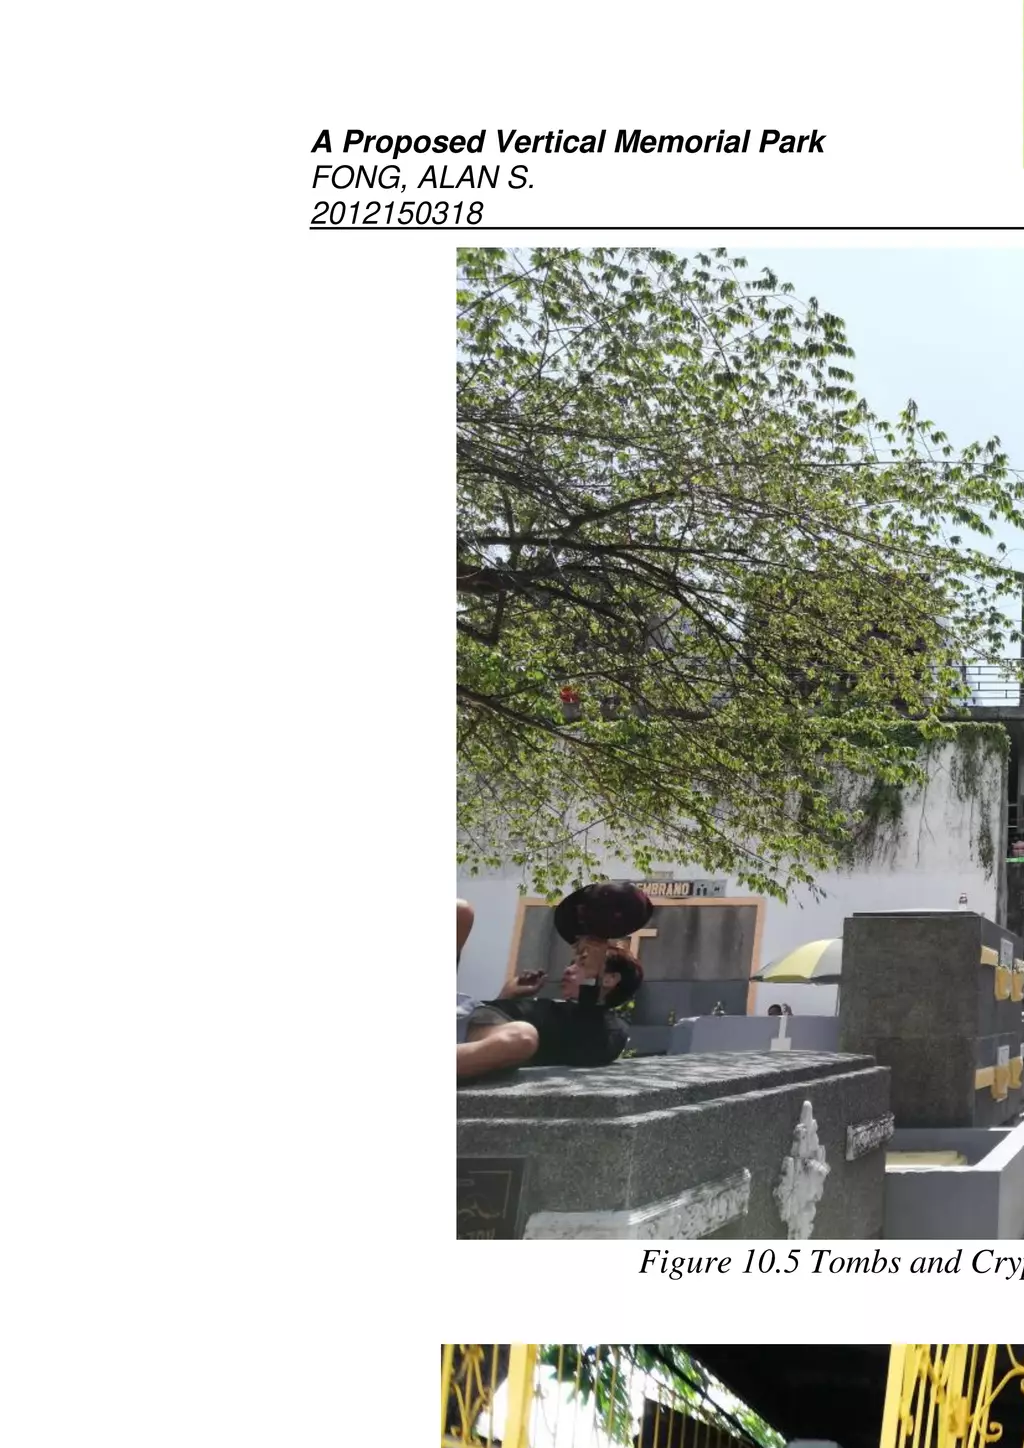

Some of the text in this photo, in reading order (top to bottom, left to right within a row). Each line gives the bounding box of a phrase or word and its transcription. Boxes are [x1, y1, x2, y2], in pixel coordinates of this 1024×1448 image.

[311, 130, 826, 159] A Proposed Vertical Memorial Park
[313, 165, 533, 193] FONG, ALAN S.
[311, 201, 483, 224] 2012150318
[629, 882, 690, 896] EMBRANO
[639, 1250, 731, 1280] Figure
[742, 1249, 800, 1274] 10.5
[811, 1249, 901, 1274] Tombs
[910, 1249, 962, 1274] and
